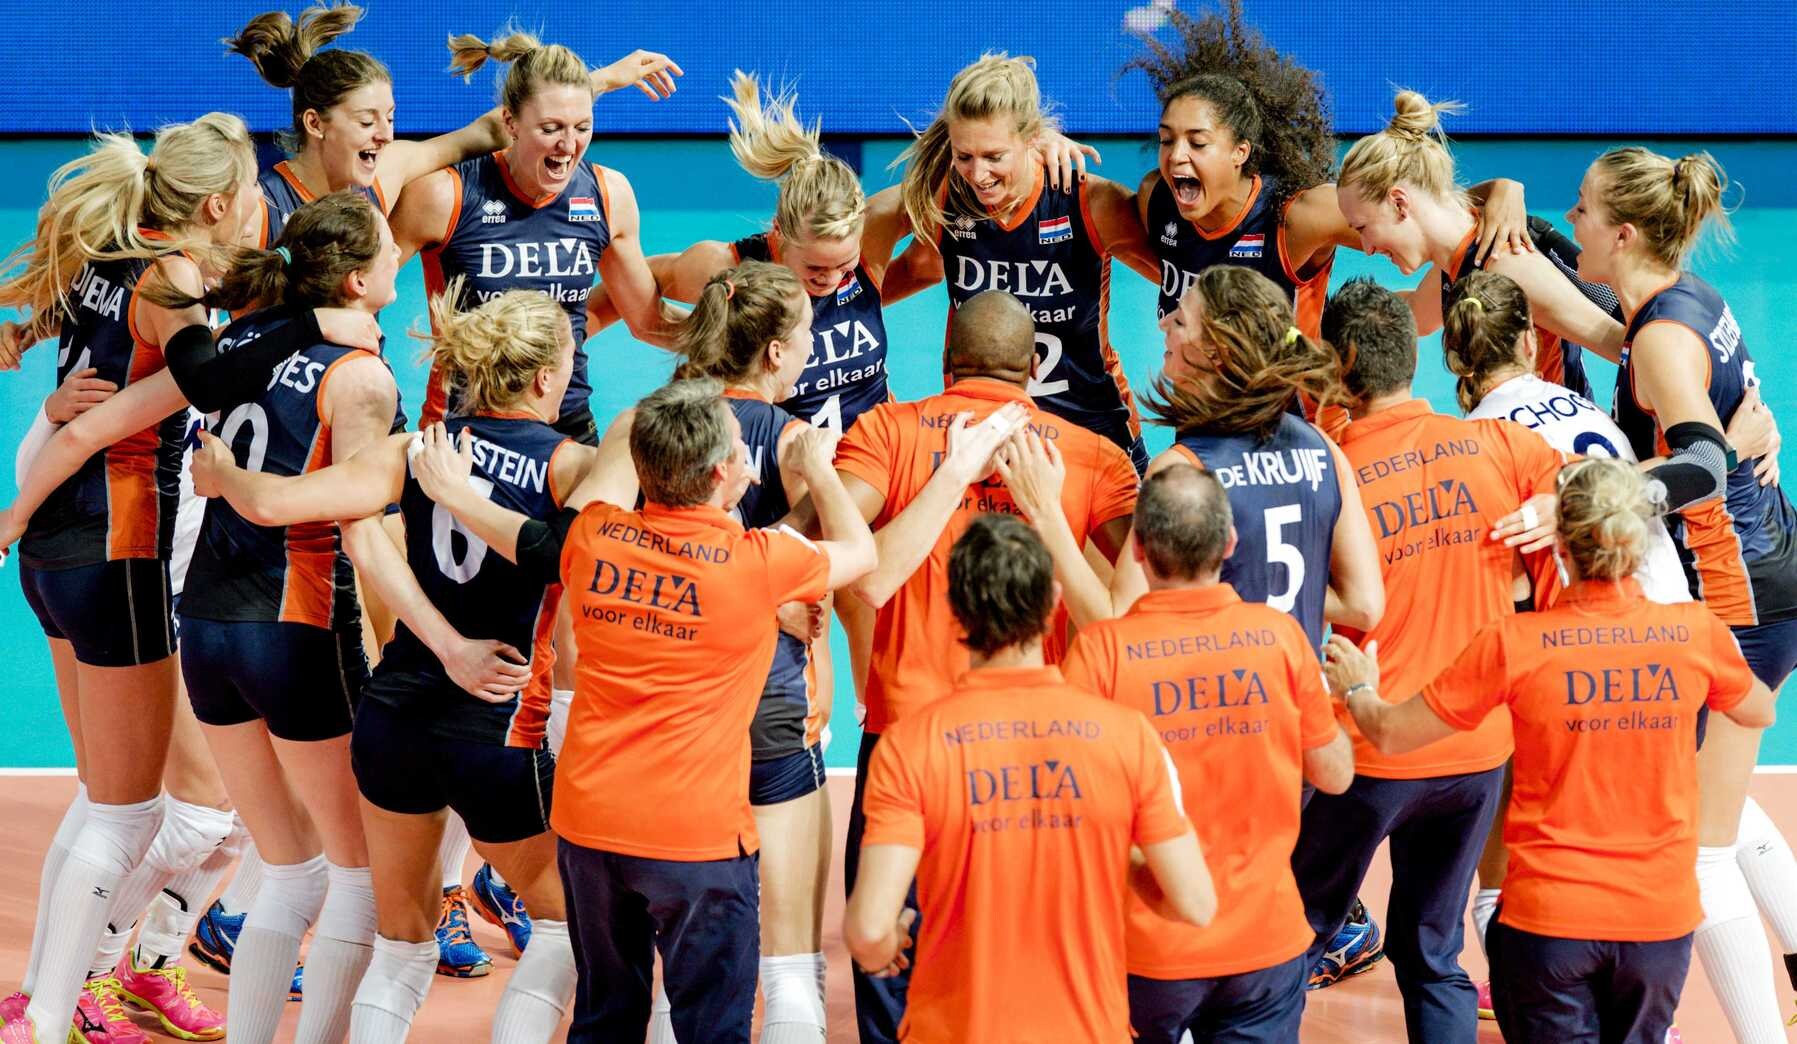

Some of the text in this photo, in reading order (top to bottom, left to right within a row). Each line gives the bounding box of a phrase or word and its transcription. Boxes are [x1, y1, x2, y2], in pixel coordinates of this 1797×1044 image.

[476, 238, 595, 278] DELA
[1041, 233, 1073, 244] NED
[954, 254, 1074, 297] DELA
[816, 358, 883, 391] elkaar
[1215, 448, 1328, 492] DE KRUIJF
[1371, 479, 1479, 540] DELA
[597, 522, 730, 564] NEDERLAND
[1263, 504, 1306, 614] 5
[586, 558, 703, 617] DELA
[582, 604, 698, 641] voor elkaar
[1542, 624, 1690, 649] NEDERLAND
[1126, 630, 1276, 661] NEDERLAND
[1151, 669, 1269, 717] DELA
[1564, 664, 1680, 706] DELA
[944, 720, 1101, 748] NEDERLAND
[1205, 715, 1269, 737] elkaar
[1565, 711, 1679, 733] voor elkaar
[966, 760, 1082, 806] DELA
